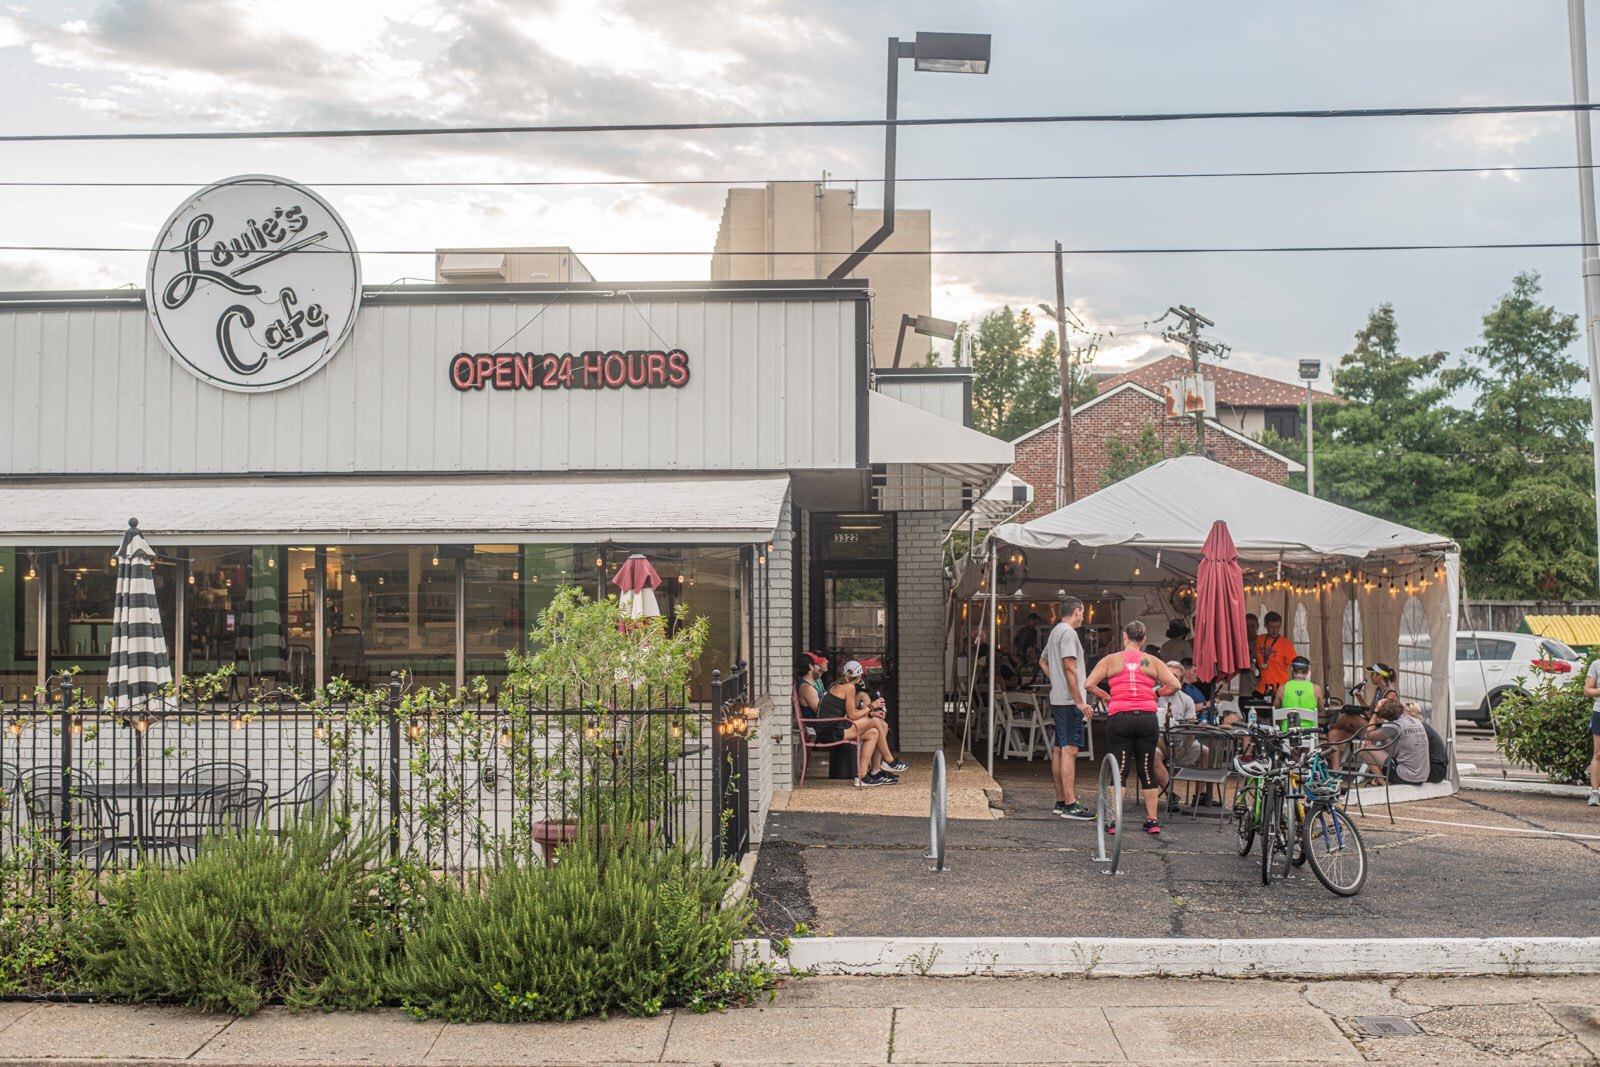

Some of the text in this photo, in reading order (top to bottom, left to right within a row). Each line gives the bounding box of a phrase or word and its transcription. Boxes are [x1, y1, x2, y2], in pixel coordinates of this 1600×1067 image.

[162, 205, 309, 310] Louie's
[452, 351, 688, 389] OPEN 24 HOURS
[835, 534, 857, 542] 3322
